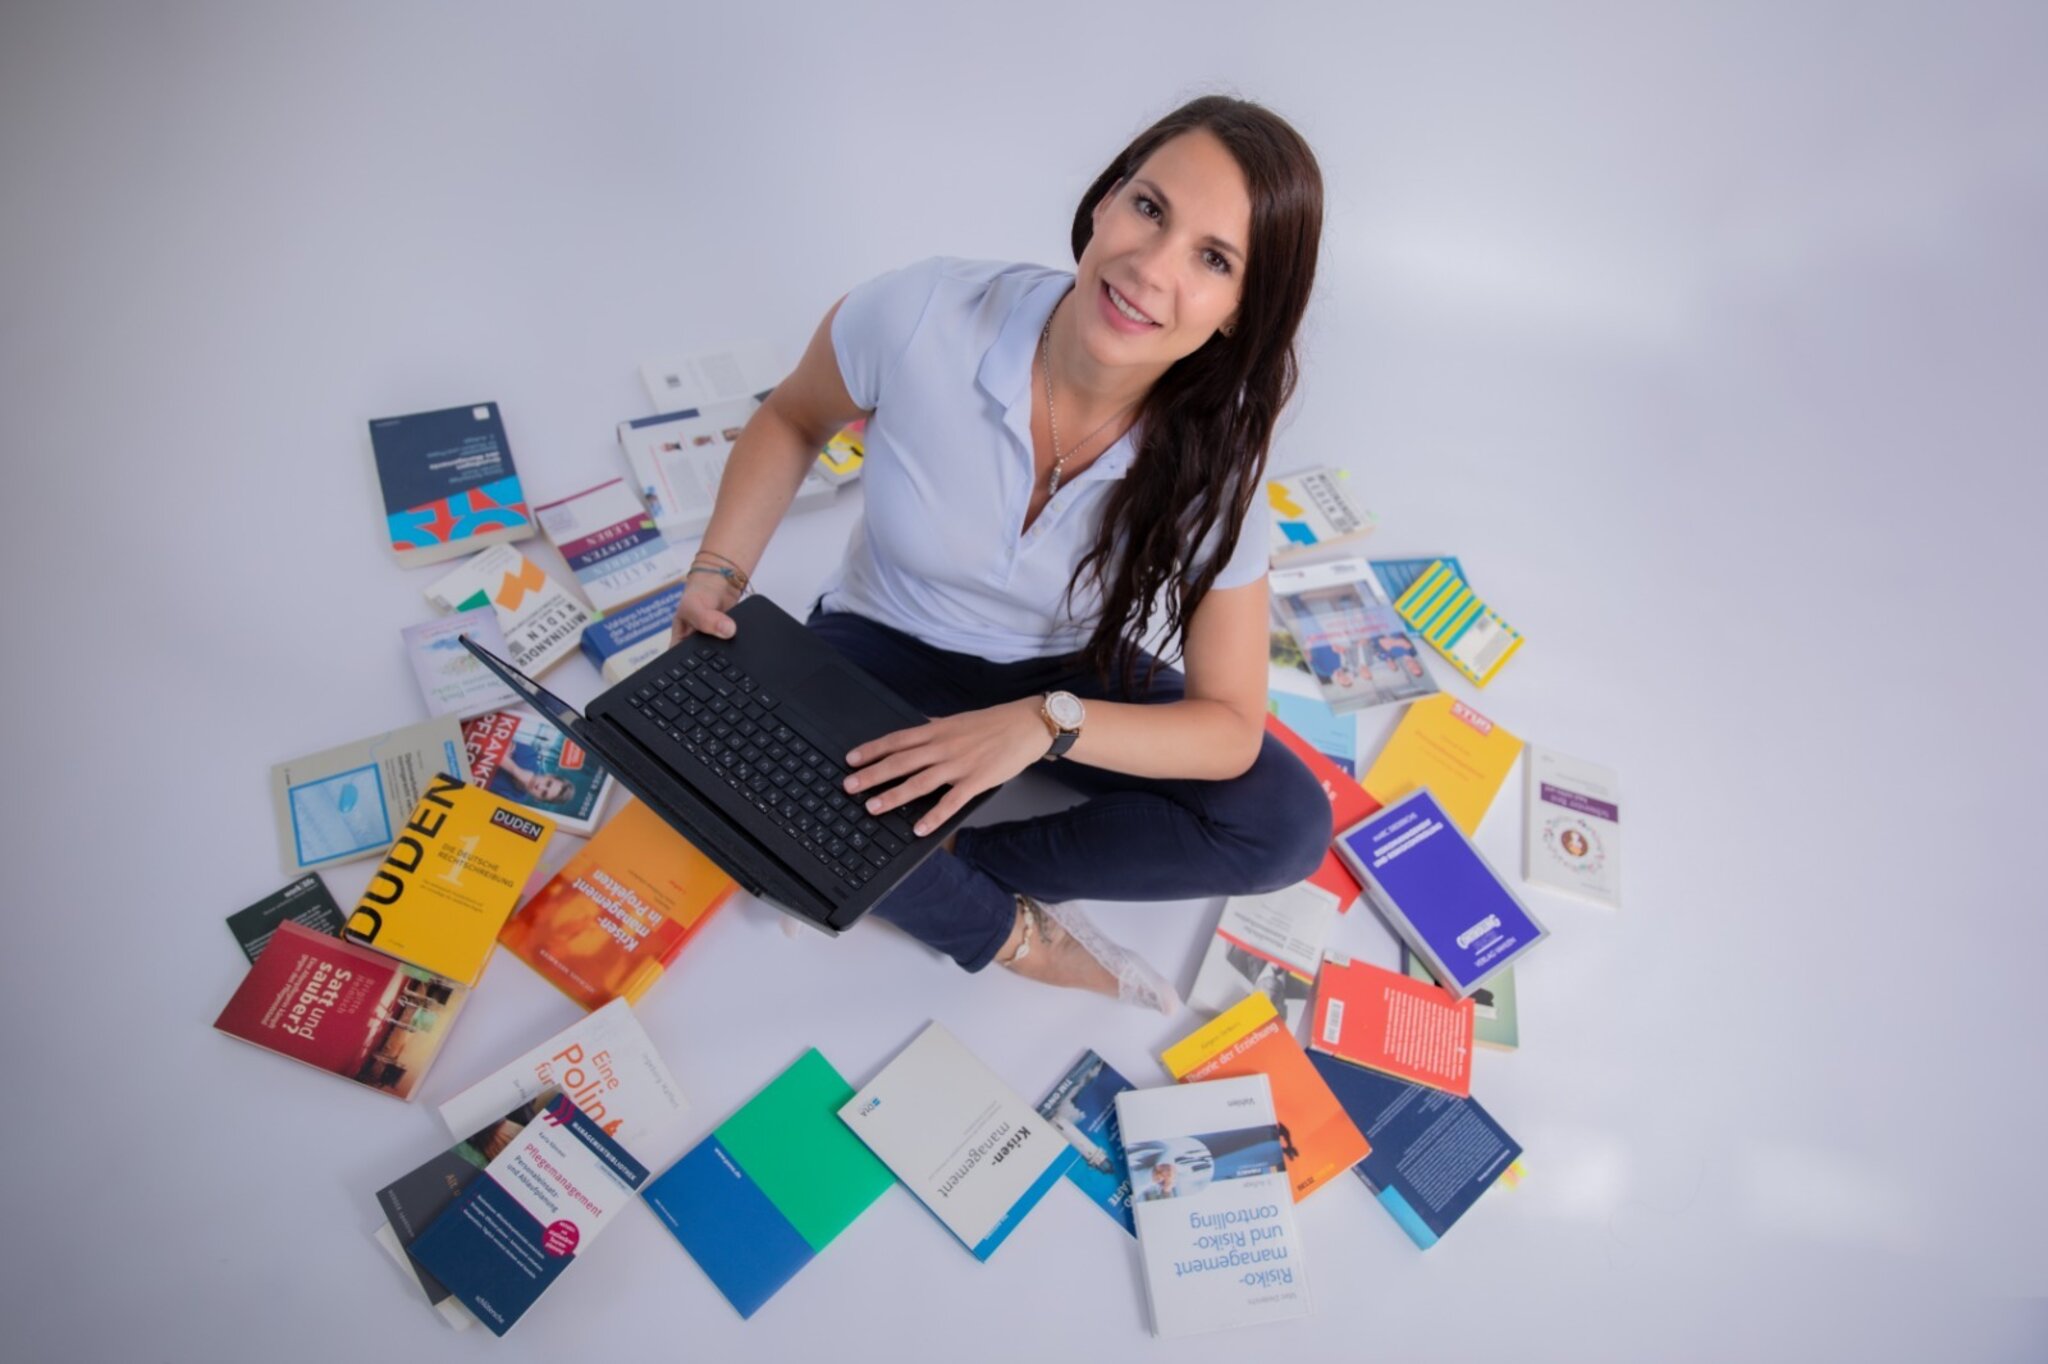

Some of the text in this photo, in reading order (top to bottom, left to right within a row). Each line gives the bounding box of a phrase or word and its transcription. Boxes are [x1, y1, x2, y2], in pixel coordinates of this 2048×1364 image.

[580, 533, 639, 564] LEISTEN
[585, 520, 631, 546] LEBEN
[515, 610, 588, 668] MITEINANDER
[525, 601, 576, 642] REDEN
[468, 714, 516, 789] KRANKE
[492, 809, 541, 838] DUDEN
[342, 766, 467, 947] DUDEN
[436, 849, 514, 888] RECHTSCHREIBUNG
[440, 843, 499, 872] DIE DEUTSCHE
[571, 873, 651, 939] management
[589, 865, 651, 917] Projekten
[593, 912, 639, 952] Krisen-
[644, 909, 662, 926] in
[281, 959, 333, 1035] sauber?
[297, 966, 353, 1041] Satt und
[335, 973, 365, 1014] Heinisch
[346, 976, 375, 1014] Brigitte
[1217, 1048, 1235, 1064] der
[1233, 1020, 1280, 1054] Erziehung
[533, 1060, 559, 1089] für
[551, 1041, 609, 1124] Polin
[590, 1049, 625, 1091] Eine
[1057, 1077, 1073, 1094] TIM
[570, 1120, 637, 1181] MANAGEMENTBIBLIOTHEK
[936, 1120, 1012, 1199] management
[989, 1124, 1032, 1168] Krisen-
[505, 1163, 520, 1177] und
[516, 1172, 559, 1213] Ablaufplanung
[512, 1153, 561, 1200] Personaleinsatz-
[521, 1142, 603, 1219] Pflegemanagement
[1189, 1204, 1278, 1230] controlling
[1192, 1225, 1283, 1251] und Risiko-
[1173, 1246, 1287, 1277] management
[1238, 1267, 1292, 1288] Risiko-
